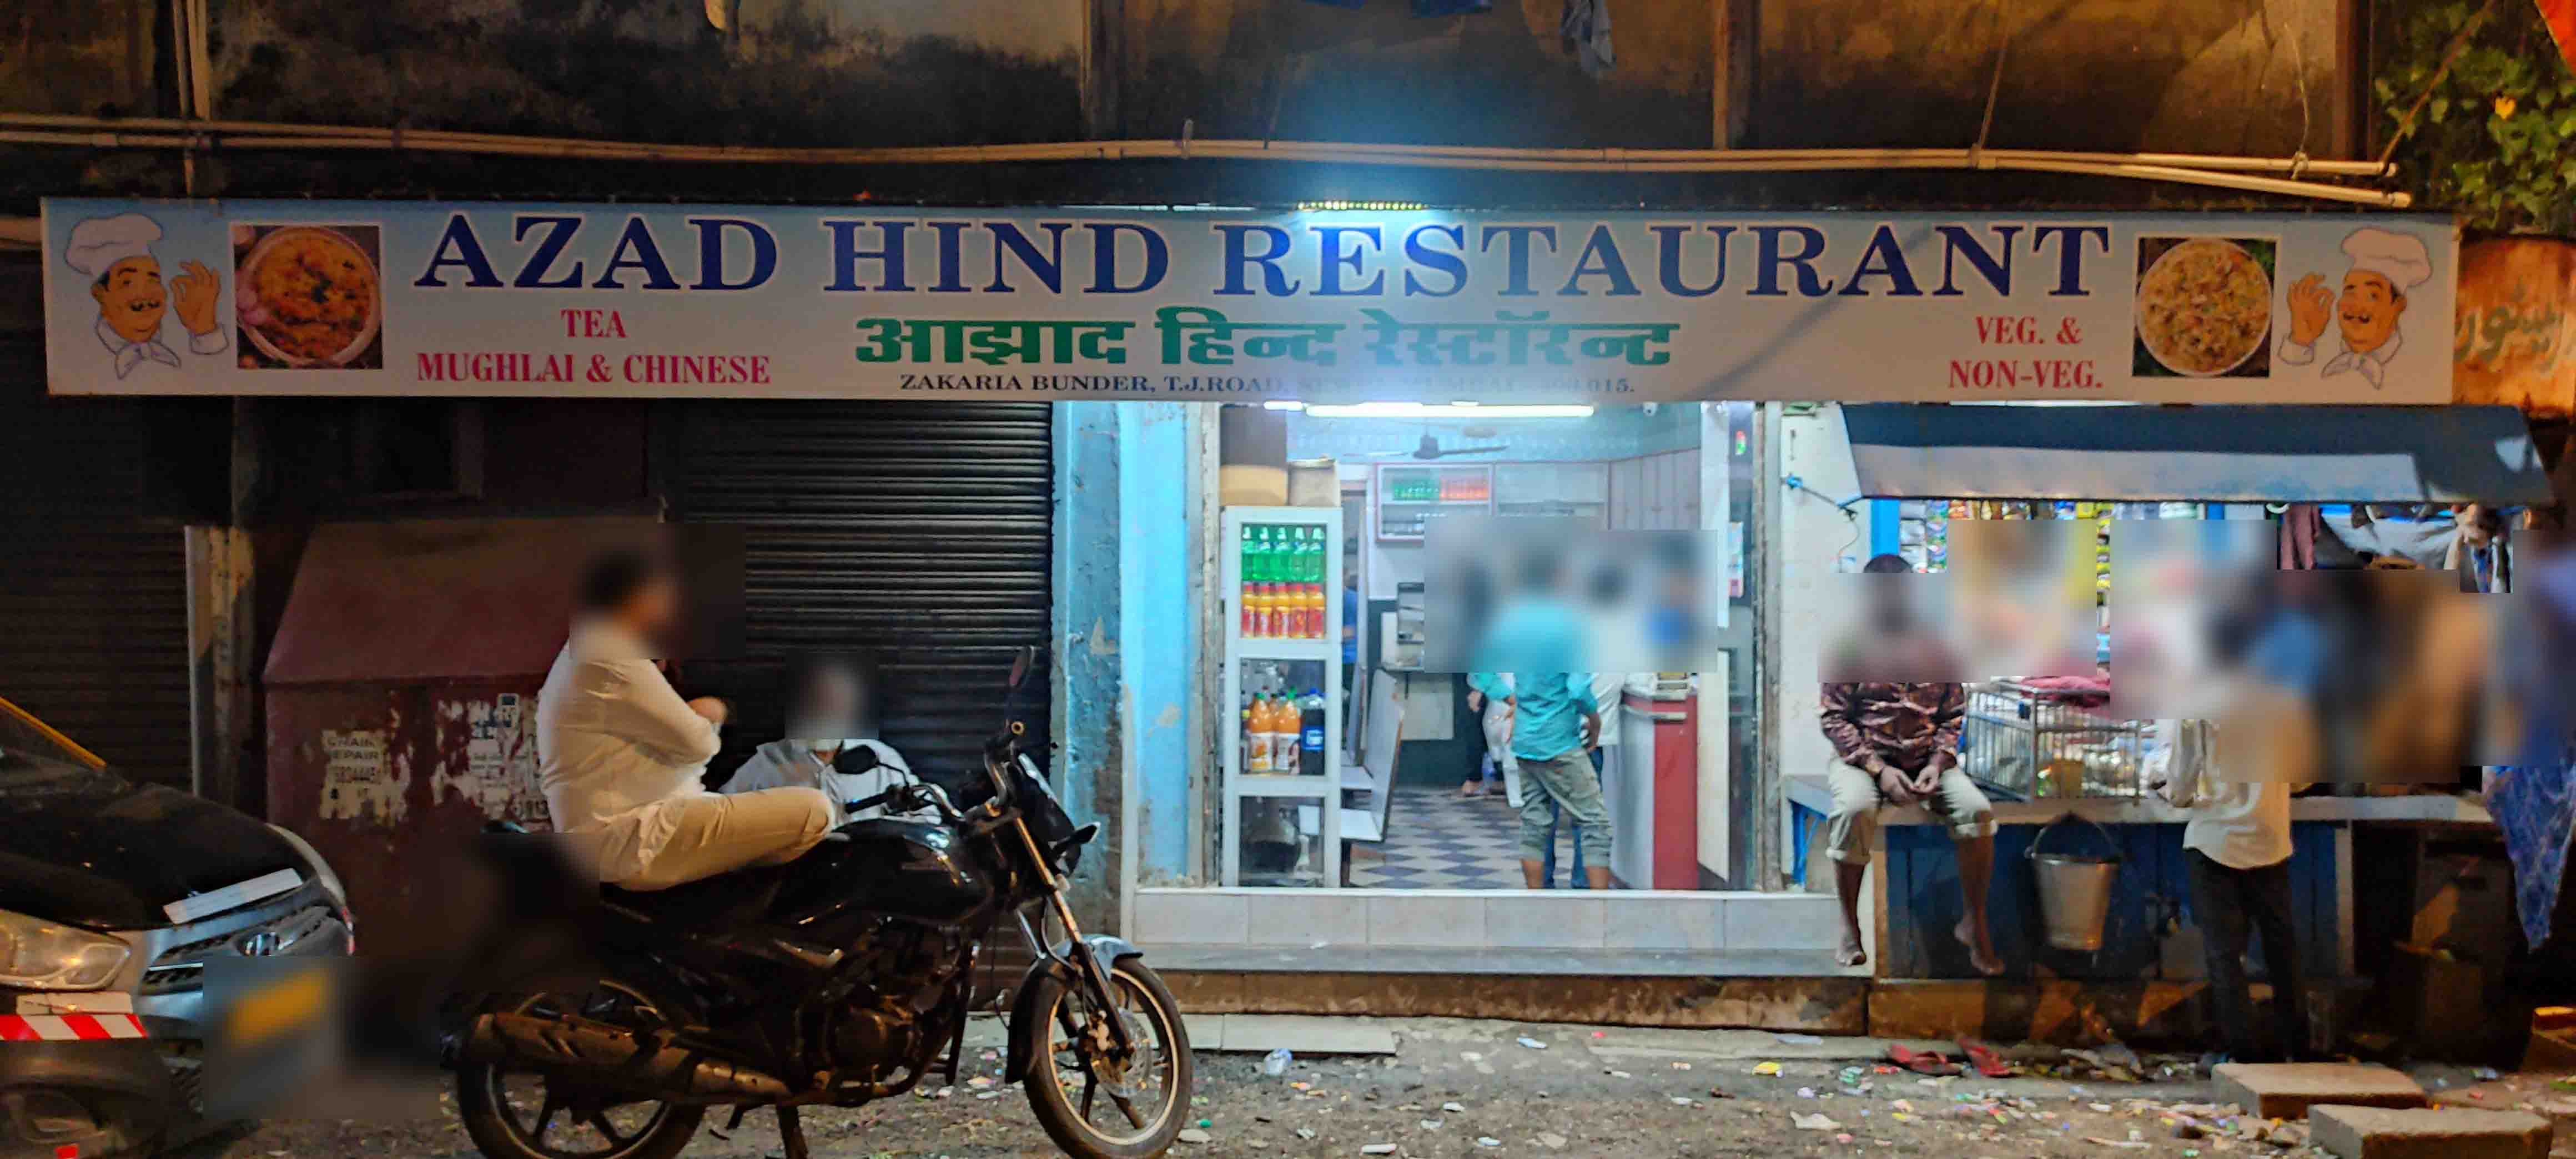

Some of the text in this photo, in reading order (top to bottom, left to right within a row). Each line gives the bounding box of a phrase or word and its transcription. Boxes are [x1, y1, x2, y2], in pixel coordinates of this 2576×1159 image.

[414, 214, 2110, 298] AZAD HIND RESTAURANT
[560, 309, 627, 339] TEA
[856, 318, 1136, 365] आझाद
[1154, 306, 1346, 365] हिन्द
[1976, 316, 2083, 345] VEG. &
[416, 352, 772, 385] MUGHLAI & CHINESE
[900, 375, 1023, 390] ZAKARIA
[1033, 376, 1155, 393] BUNDER,
[1948, 359, 2105, 390] NON-VEG.
